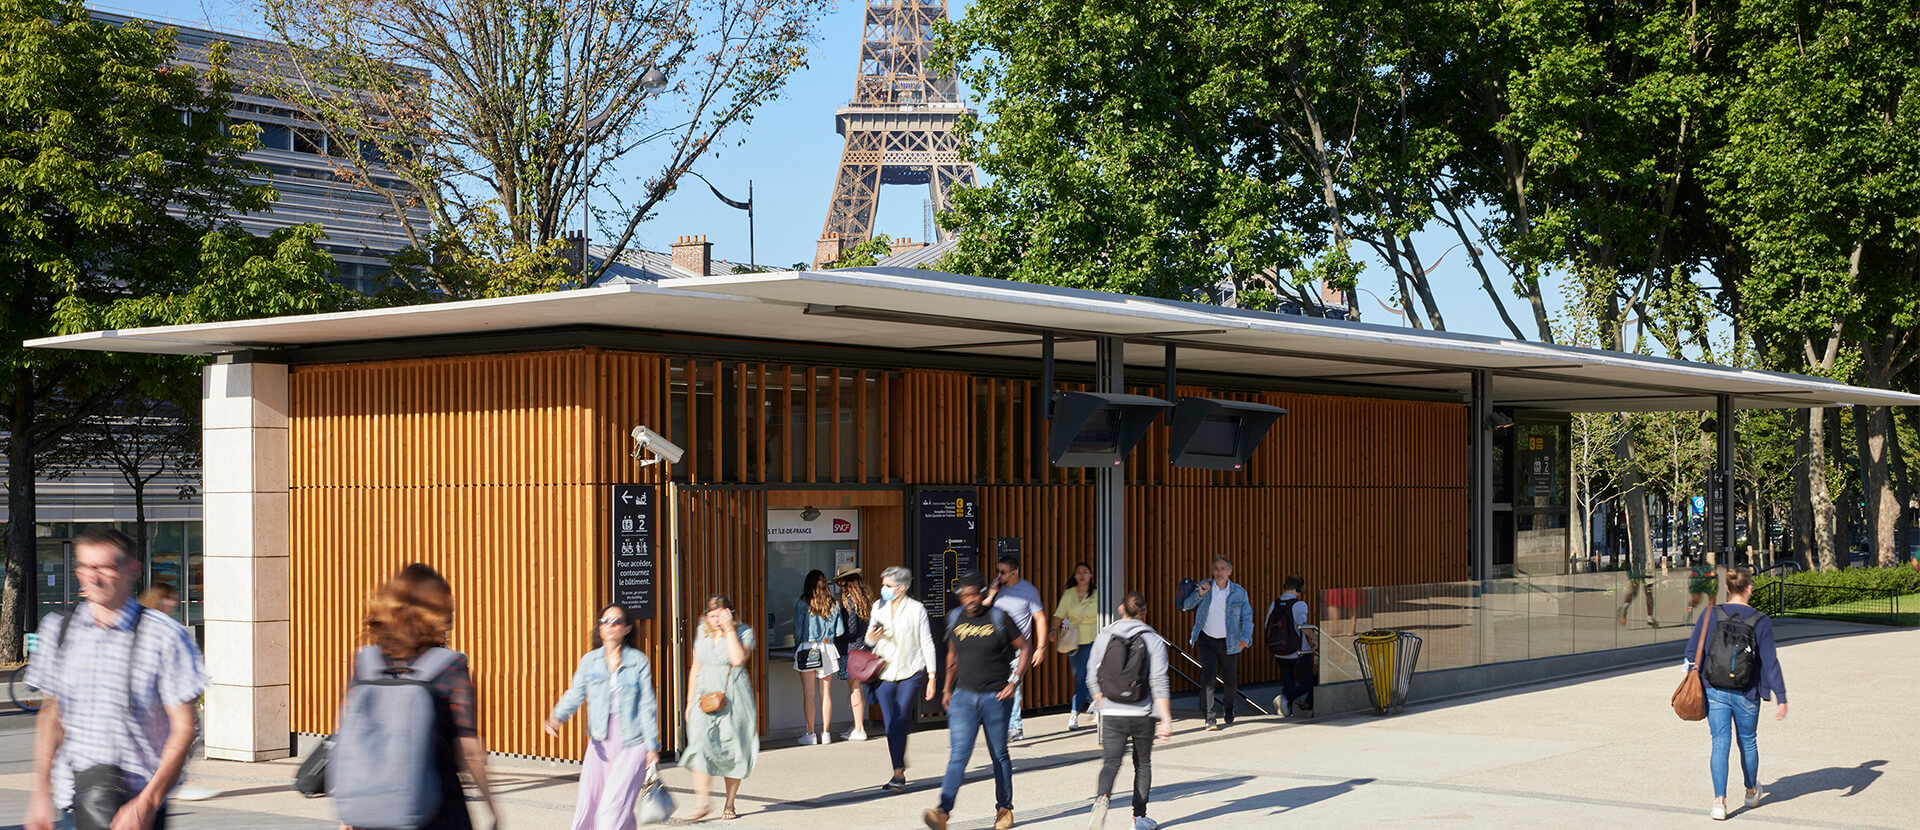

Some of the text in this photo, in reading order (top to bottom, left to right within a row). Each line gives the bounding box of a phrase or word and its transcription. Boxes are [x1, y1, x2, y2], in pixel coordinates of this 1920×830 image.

[1544, 461, 1549, 472] 2
[967, 506, 972, 516] 2
[639, 519, 645, 530] 2
[834, 523, 850, 532] SNCF
